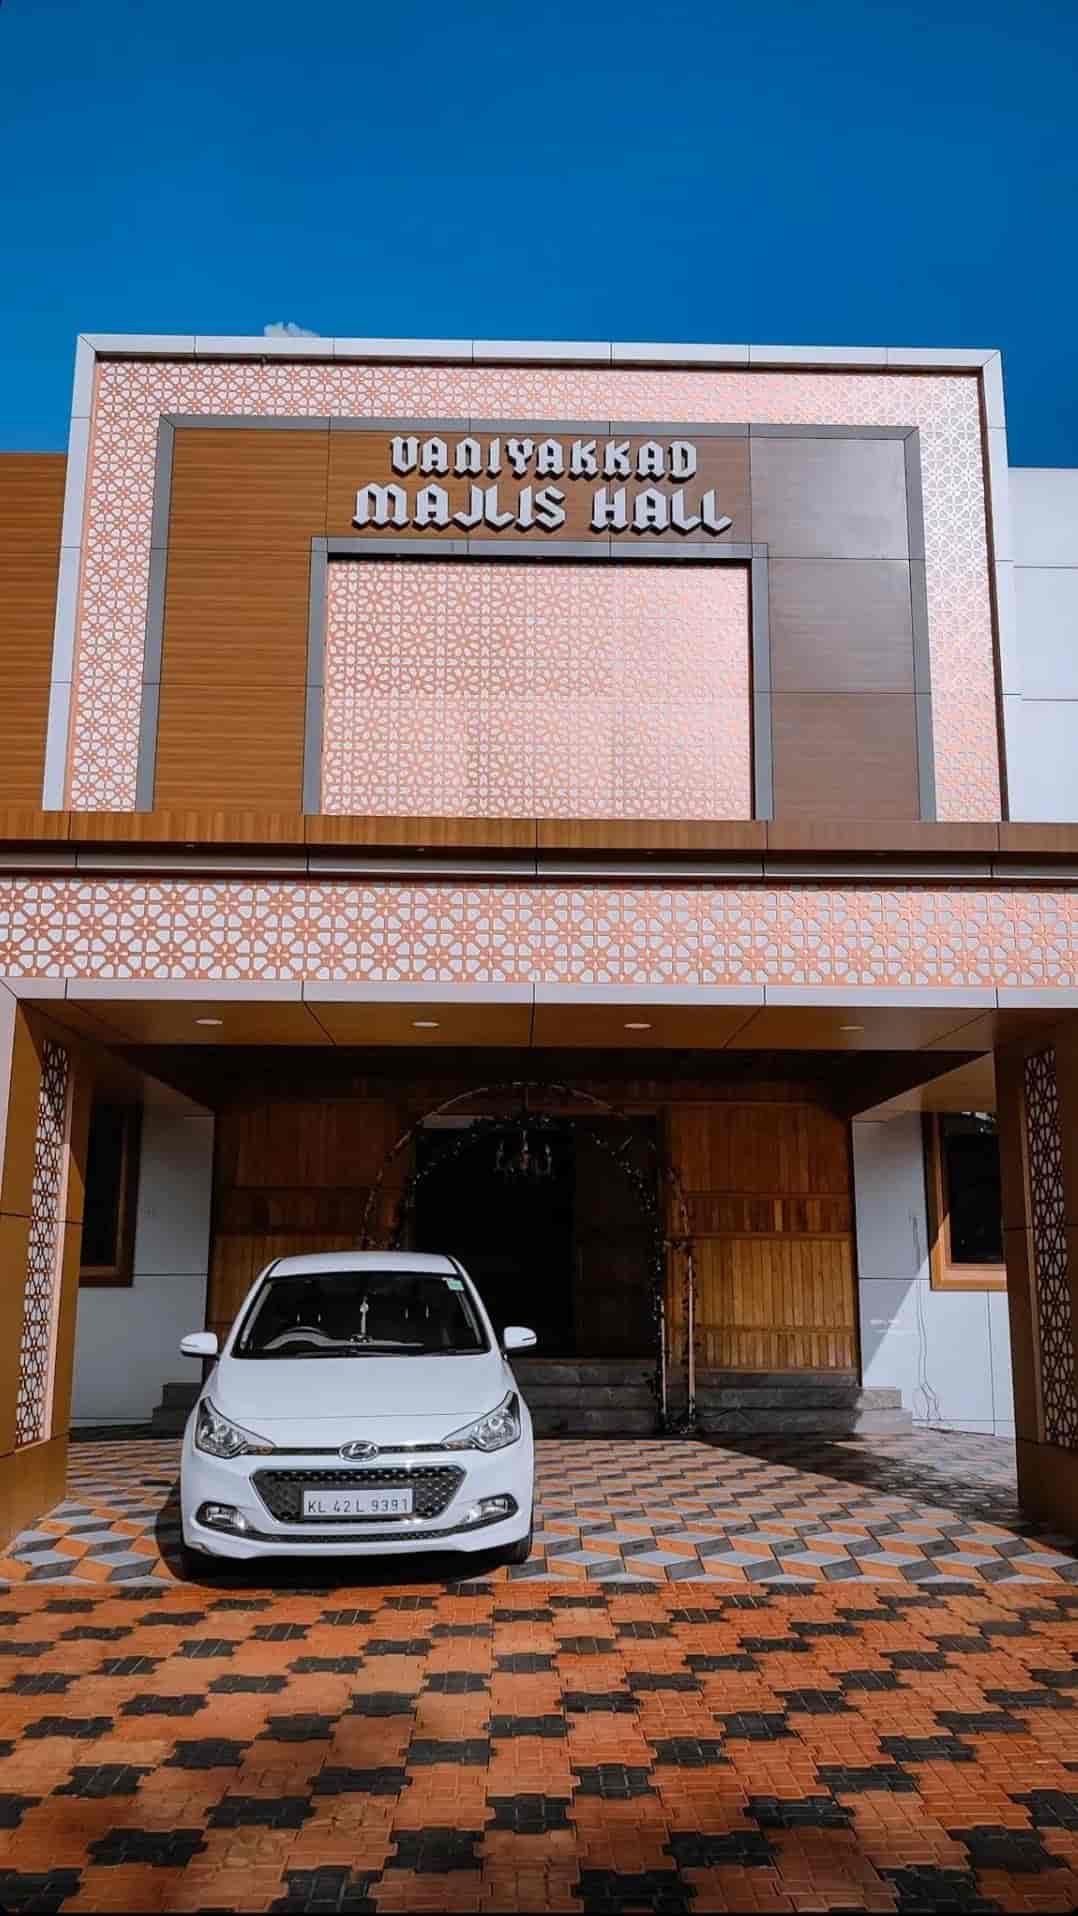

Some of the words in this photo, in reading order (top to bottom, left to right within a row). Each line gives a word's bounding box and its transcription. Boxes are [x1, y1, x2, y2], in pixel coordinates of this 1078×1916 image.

[389, 436, 698, 481] VANIYAKKAD
[352, 482, 567, 529] MAJLIS
[590, 486, 732, 535] HALL
[308, 1500, 326, 1513] KL
[333, 1500, 351, 1513] 42
[355, 1499, 365, 1513] L
